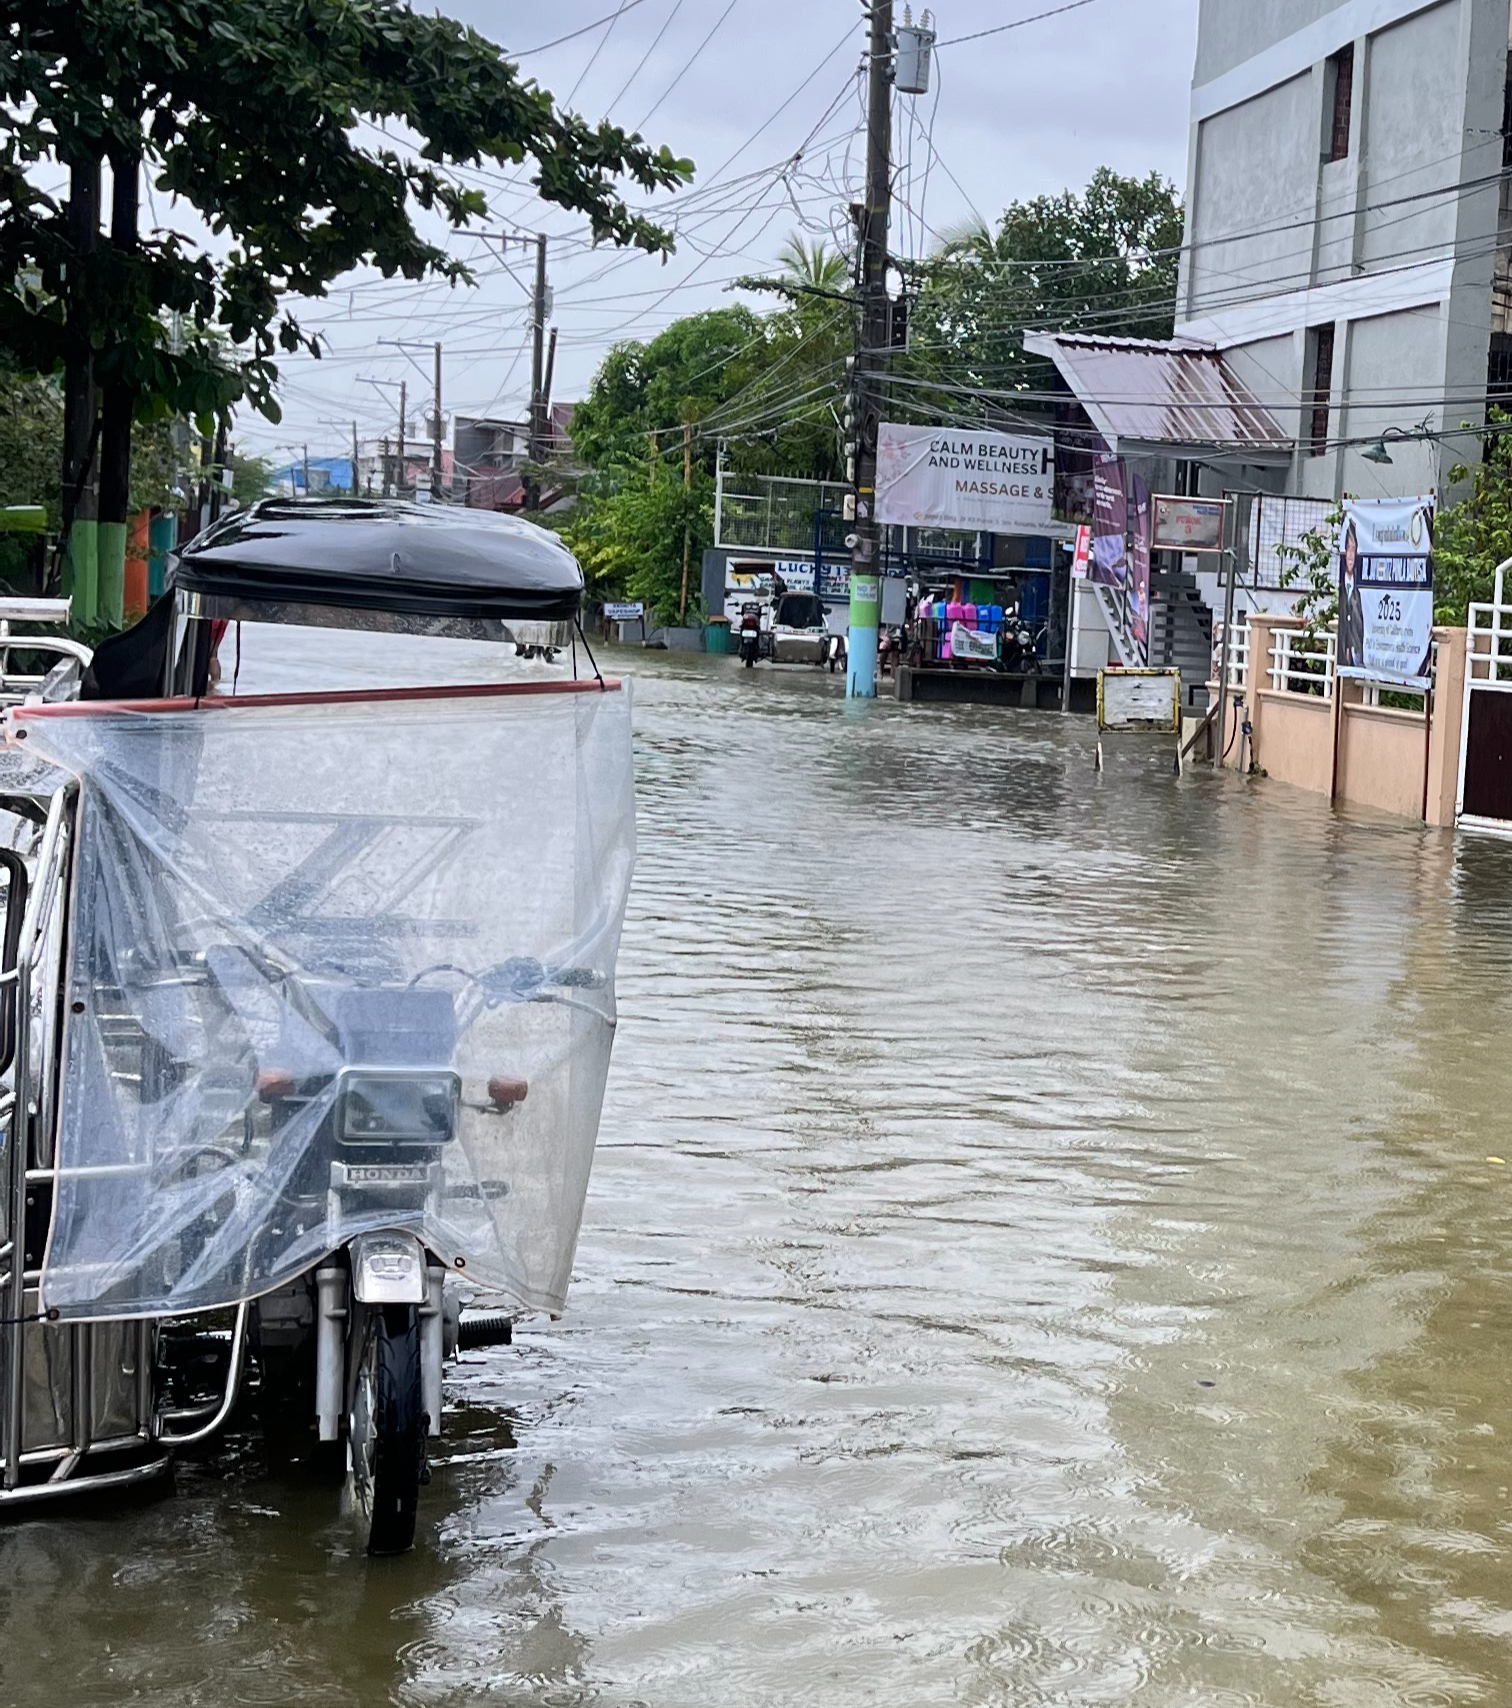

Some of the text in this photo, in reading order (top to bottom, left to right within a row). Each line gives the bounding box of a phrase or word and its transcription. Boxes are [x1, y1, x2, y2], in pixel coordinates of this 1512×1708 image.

[930, 440, 973, 455] CALM
[978, 444, 1039, 461] BEAUTY
[928, 456, 1038, 475] AND WELLNESS
[955, 480, 1030, 498] MASSAGE
[1033, 486, 1044, 499] &
[1378, 600, 1401, 621] 2025
[350, 1168, 424, 1181] HONDA
